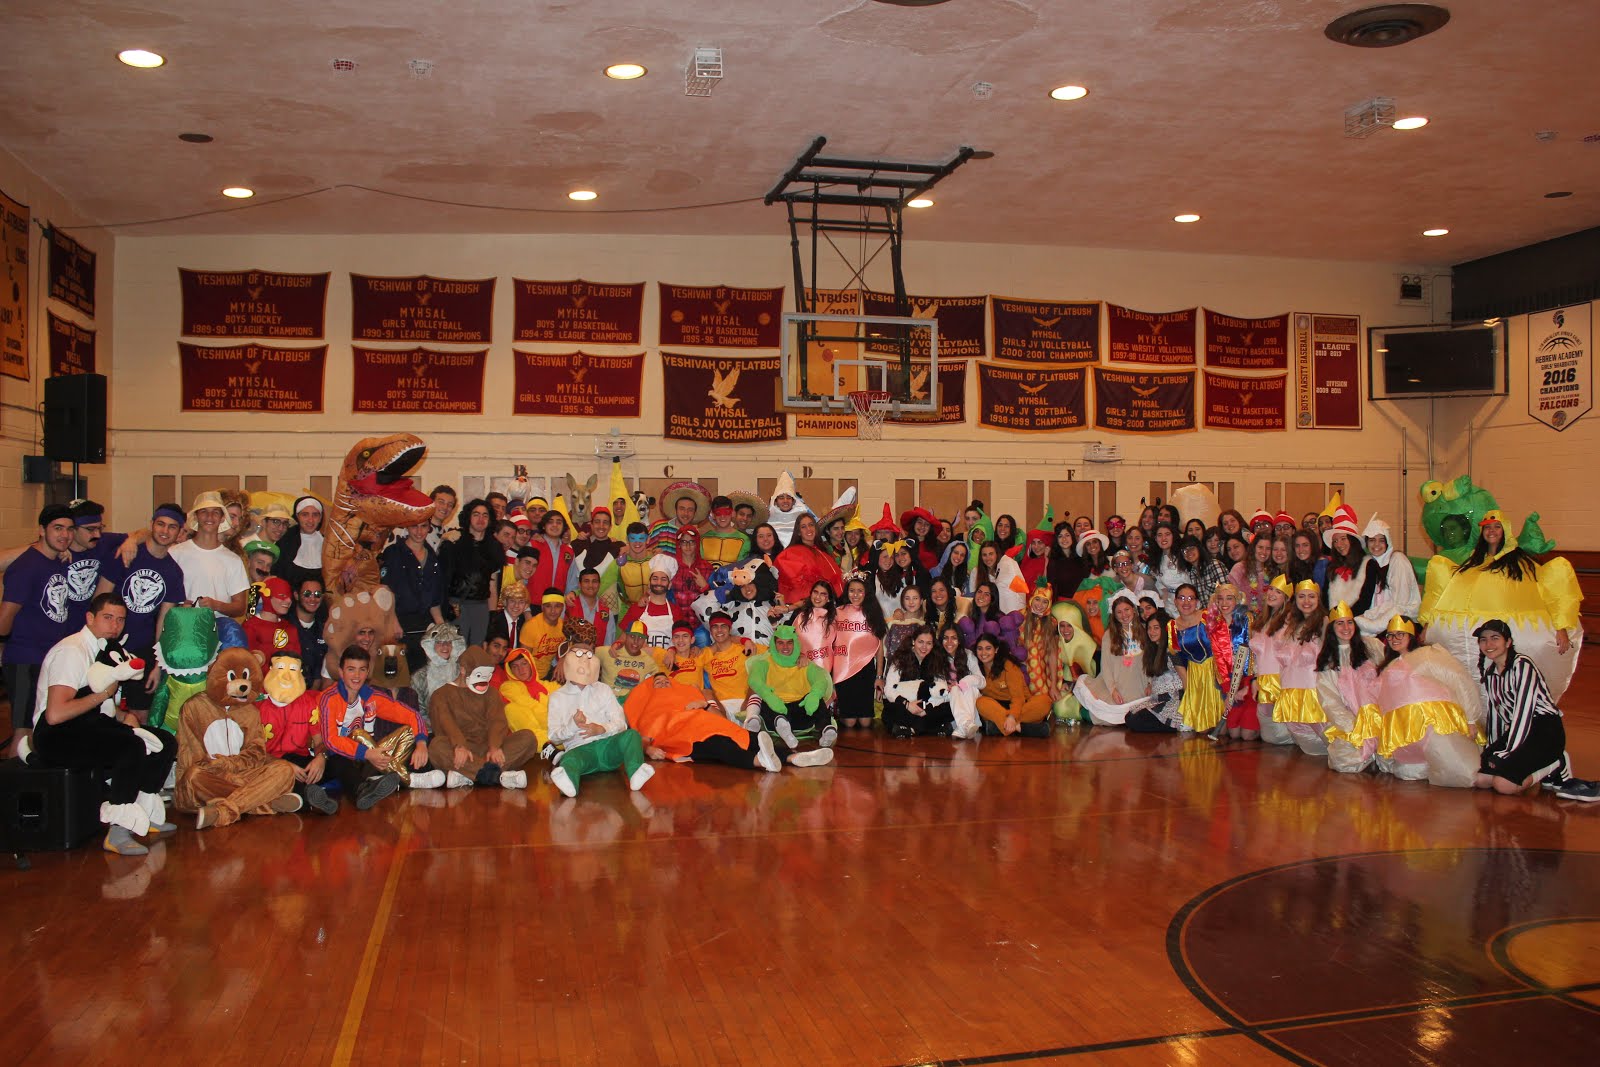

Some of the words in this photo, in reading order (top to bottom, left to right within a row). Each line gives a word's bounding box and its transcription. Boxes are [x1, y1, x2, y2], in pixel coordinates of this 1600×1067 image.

[198, 274, 242, 286] YESHIVAH
[248, 273, 259, 285] OF
[264, 275, 312, 288] FLATBUSH
[367, 280, 412, 292] YESHIVAH
[417, 279, 428, 291] OF
[433, 281, 480, 294] FLATBUSH
[526, 284, 568, 295] YESHIVAH
[572, 284, 583, 294] OF
[588, 285, 632, 297] FLATBUSH
[672, 287, 712, 299] YESHIVAH
[716, 288, 727, 299] OF
[731, 289, 772, 301] FLATBUSH
[806, 292, 857, 303] LATBUSH
[230, 302, 278, 314] MYHSAL
[918, 298, 931, 306] OF
[934, 298, 985, 307] FLATBUSH
[400, 307, 447, 319] MYHSAL
[557, 308, 599, 320] MYHSAL
[1001, 303, 1037, 314] YESHIVAH
[1040, 306, 1049, 315] OF
[1053, 307, 1092, 316] FLATBUSH
[225, 314, 246, 324] BOYS
[251, 315, 282, 324] HOCKEY
[382, 319, 406, 328] GIRLS
[414, 320, 463, 330] VOLLEYBALL
[701, 315, 741, 326] MYHSAL
[233, 325, 264, 335] LEAGUE
[269, 326, 313, 336] CHAMPIONS
[536, 320, 555, 329] BOYS
[559, 320, 569, 329] JV
[573, 321, 619, 331] BASKETBALL
[681, 325, 700, 334] BOYS
[703, 326, 712, 334] JV
[716, 327, 759, 336] BASKETBALL
[363, 329, 395, 338] 1990-91
[400, 329, 430, 339] LEAGUE
[438, 331, 482, 340] CHAMPIONS
[521, 329, 554, 338] 1994-95
[559, 330, 586, 340] LEAGUE
[591, 331, 633, 341] CHAMPIONS
[1032, 330, 1062, 340] MYHSAL
[1137, 334, 1169, 345] MYHSL
[719, 336, 758, 345] CHAMPIONS
[919, 339, 980, 348] VOLEYBALL
[1002, 337, 1026, 347] GIRLS
[1028, 340, 1038, 349] JV
[1041, 340, 1091, 350] VOLLEYBALL
[923, 347, 980, 355] CAMPIONS
[1112, 342, 1130, 351] GIRLS
[1131, 343, 1155, 353] VARSITY
[1158, 345, 1193, 354] VOLLEYBALL
[1322, 343, 1351, 351] LEAGUE
[196, 348, 242, 360] YESHIVAH
[247, 348, 258, 359] OF
[262, 349, 310, 362] FLATBUSH
[364, 352, 407, 365] YESHIVAH
[412, 352, 423, 364] OF
[429, 353, 475, 366] FLATBUSH
[1049, 350, 1093, 359] CHAMPIONS
[1138, 353, 1159, 362] LEAGUE
[1161, 354, 1193, 363] CHAMPIONS
[526, 355, 567, 367] YESHIVAH
[572, 354, 583, 366] OF
[588, 356, 633, 369] FLATBUSH
[663, 356, 715, 369] YESHIVAH
[719, 360, 732, 370] OF
[735, 359, 781, 371] FLATBUS
[987, 369, 1023, 381] YESHIVAH
[1026, 373, 1036, 381] OF
[1040, 372, 1079, 382] FLATBUSH
[1102, 373, 1136, 384] YESHIVAH
[1139, 376, 1149, 384] OF
[1153, 376, 1188, 384] FLATBUSH
[1543, 367, 1577, 386] 2016
[228, 376, 276, 389] MYHSAL
[397, 377, 440, 389] MYHSAL
[1208, 376, 1240, 390] YESHIVAH
[1241, 381, 1250, 390] OF
[1251, 379, 1283, 391] FLATBUSH
[205, 388, 227, 397] BOYS
[231, 388, 242, 397] JV
[248, 389, 299, 399] BASKETBALL
[557, 383, 599, 395] MYHSAL
[1539, 383, 1579, 395] CHAMPIONS
[386, 390, 407, 399] BOYS
[412, 390, 449, 400] SOFTBALL
[519, 394, 541, 403] GIRLS
[545, 394, 590, 404] VOLLEYBALL
[594, 395, 635, 405] CHAMPIONS
[191, 399, 224, 408] 1990-91
[230, 399, 262, 408] LEAGUE
[268, 400, 313, 410] CHAMPIONS
[358, 400, 388, 409] 1991-92
[392, 400, 420, 409] LEAGUE
[423, 400, 477, 410] CO-CHAMPIONS
[1018, 397, 1049, 406] MYHSAL
[1132, 399, 1160, 408] MYHSAL
[1539, 398, 1579, 410] FALCONS
[705, 408, 748, 418] MYHSAL
[994, 404, 1015, 414] BOYS
[1019, 407, 1029, 416] JV
[1105, 407, 1127, 417] GIRLS
[1130, 409, 1139, 418] JV
[1142, 409, 1186, 418] BASKETBALL
[670, 414, 700, 426] GIRLS
[702, 418, 715, 428] JV
[718, 417, 782, 429] VOLLEYBALL
[797, 419, 857, 430] CHAMPIONS
[1035, 415, 1078, 426] CHAMPIONS
[1148, 418, 1186, 428] CHAMPIONS
[1232, 417, 1264, 426] CHAMPIONS
[670, 426, 720, 439] 2004-2005
[722, 427, 782, 440] CHAMPIONS
[664, 465, 675, 478] C
[803, 466, 814, 478] D
[936, 467, 946, 479] E
[1066, 469, 1075, 481] F
[1187, 471, 1196, 482] G
[646, 635, 671, 649] HEF
